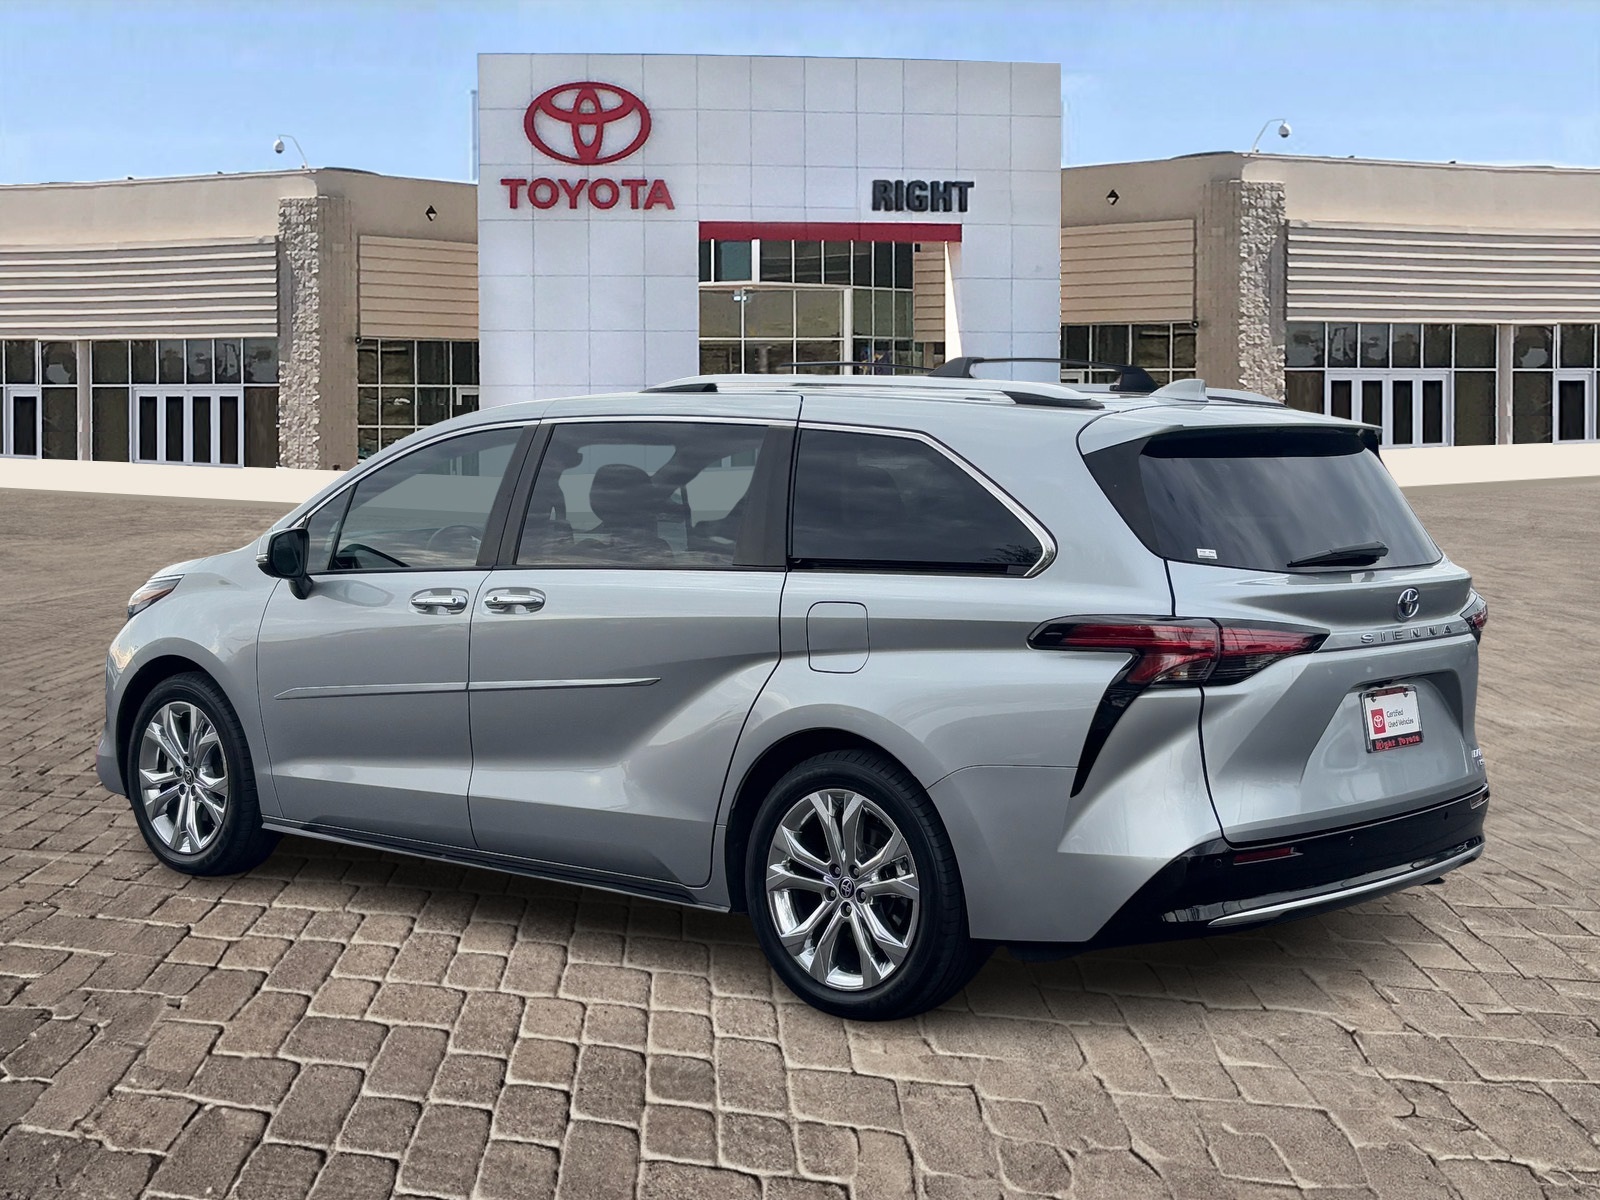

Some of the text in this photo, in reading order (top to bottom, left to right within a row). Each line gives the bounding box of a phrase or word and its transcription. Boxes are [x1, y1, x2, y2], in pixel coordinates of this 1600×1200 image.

[500, 178, 675, 210] TOYOTA
[872, 179, 975, 212] RIGHT
[1361, 624, 1452, 644] SIENNA
[1386, 709, 1404, 718] Certified
[1388, 717, 1415, 728] Used Vehicles
[1375, 735, 1420, 750] Right Toyota
